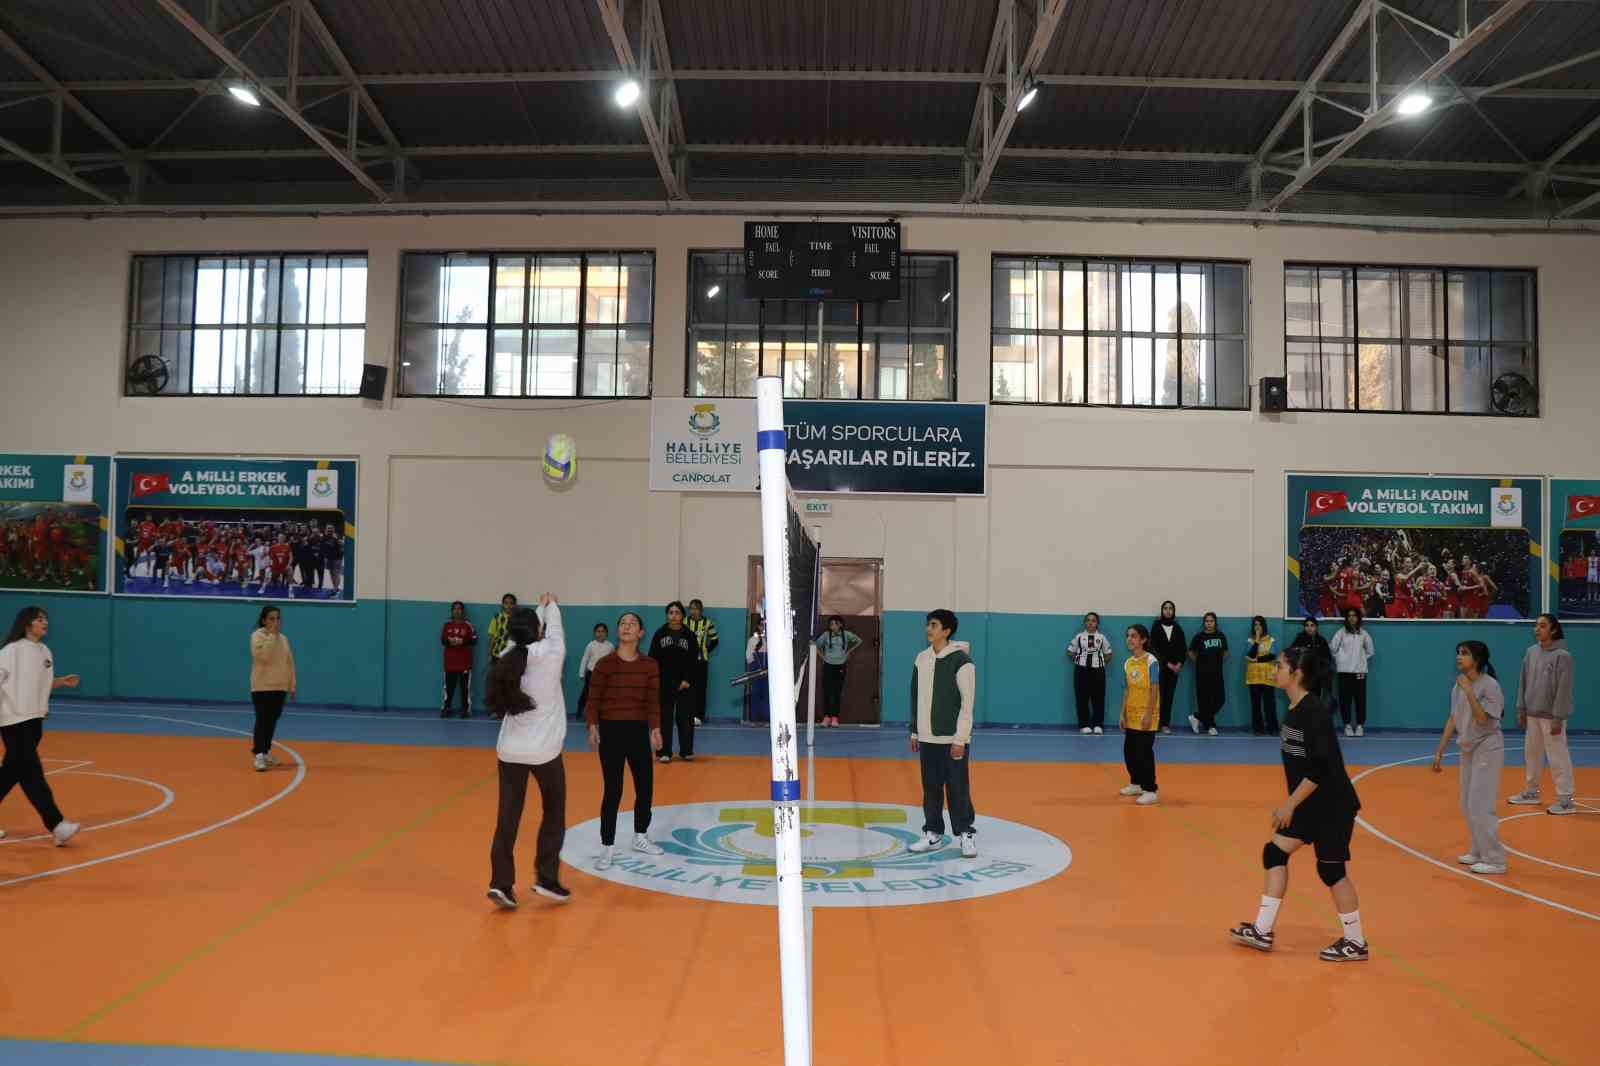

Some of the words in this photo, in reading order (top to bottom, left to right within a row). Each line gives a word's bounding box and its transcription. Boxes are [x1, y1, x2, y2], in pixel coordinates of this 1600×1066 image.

[754, 225, 780, 238] HOME
[851, 226, 896, 239] VISITORS
[809, 242, 832, 250] TIME
[758, 270, 779, 279] SCORE
[811, 269, 831, 278] PERIOD
[870, 271, 891, 280] SCORE
[784, 421, 826, 441] TÜM
[831, 425, 962, 443] SPORCULARA
[785, 449, 889, 470] AŞARILAR
[892, 447, 976, 468] DİLERİZ.
[182, 471, 193, 481] A
[239, 471, 287, 482] ERKEK
[672, 473, 731, 483] CANPOLAT
[168, 484, 246, 495] VOLEYBOL
[248, 485, 301, 496] TAKIMI
[1361, 488, 1373, 500] A
[1421, 490, 1469, 501] KADIN
[807, 503, 828, 511] EXIT
[1346, 502, 1428, 513] VOLEYBOL
[1431, 503, 1484, 515] TAKIMI
